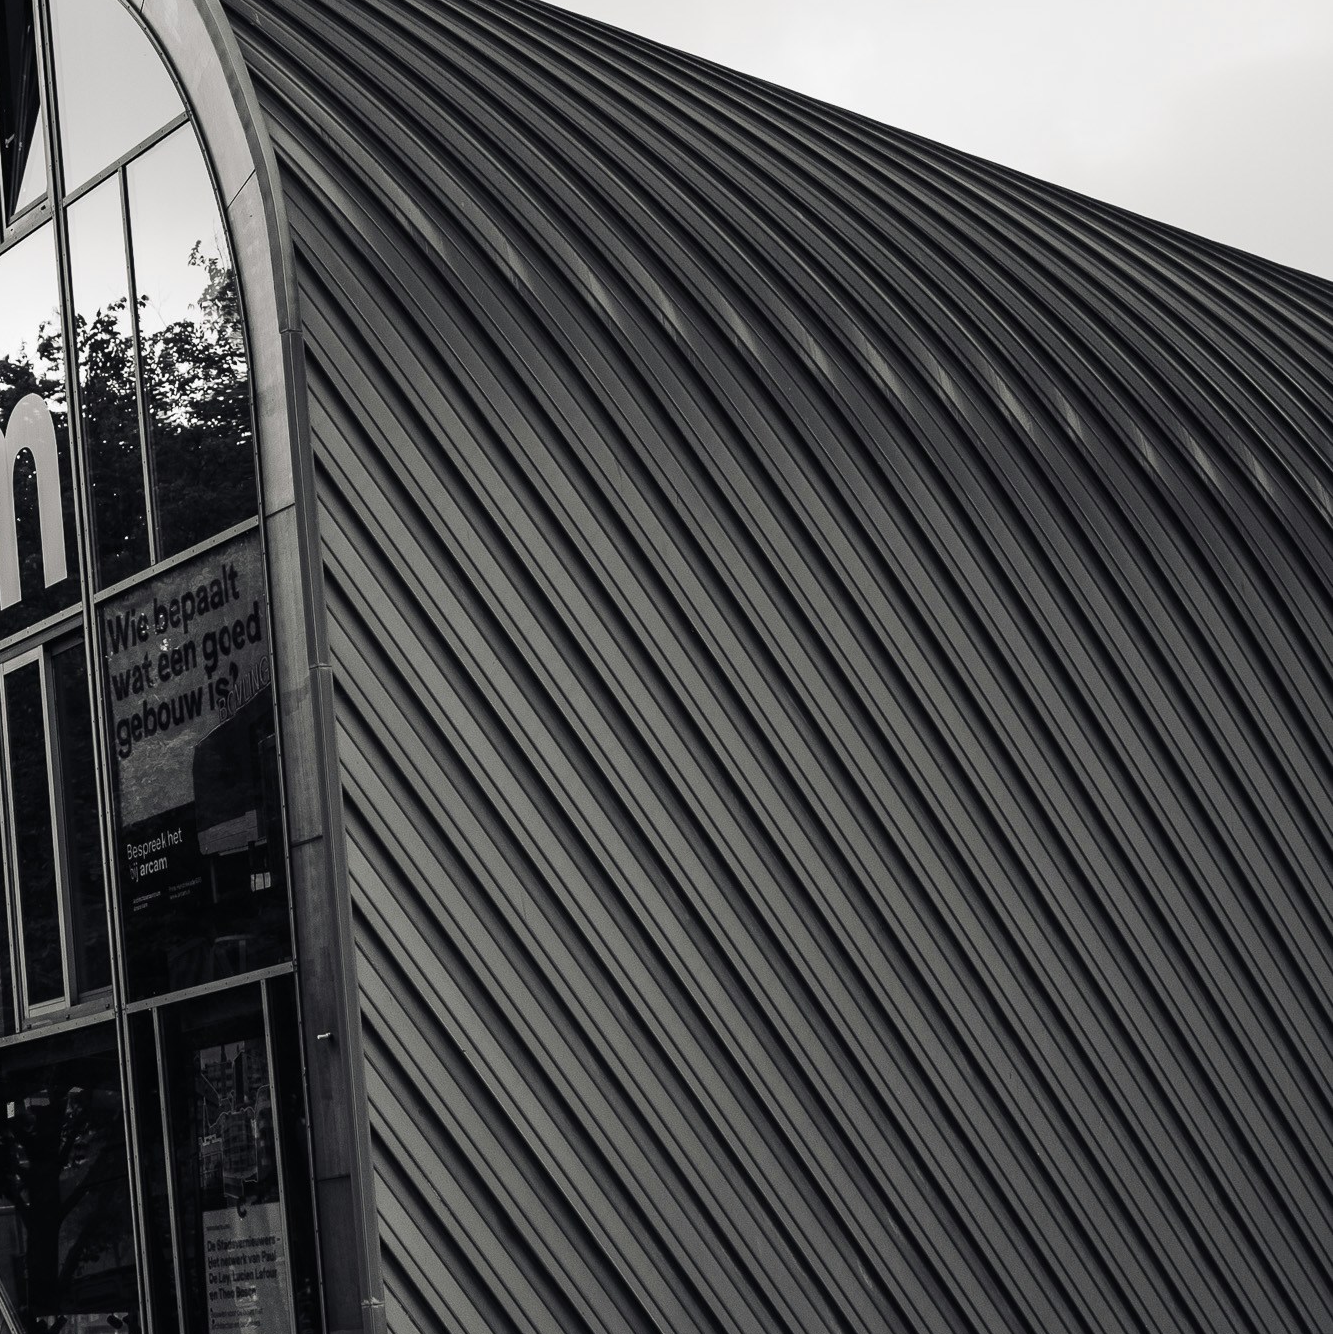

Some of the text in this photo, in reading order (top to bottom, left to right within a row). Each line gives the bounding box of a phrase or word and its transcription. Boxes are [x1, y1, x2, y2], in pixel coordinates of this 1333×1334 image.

[107, 563, 240, 653] Wie bepaalt
[113, 600, 262, 701] wat een goed
[117, 686, 203, 759] gebouw
[126, 827, 183, 860] Bespreek het
[140, 856, 168, 877] arcam
